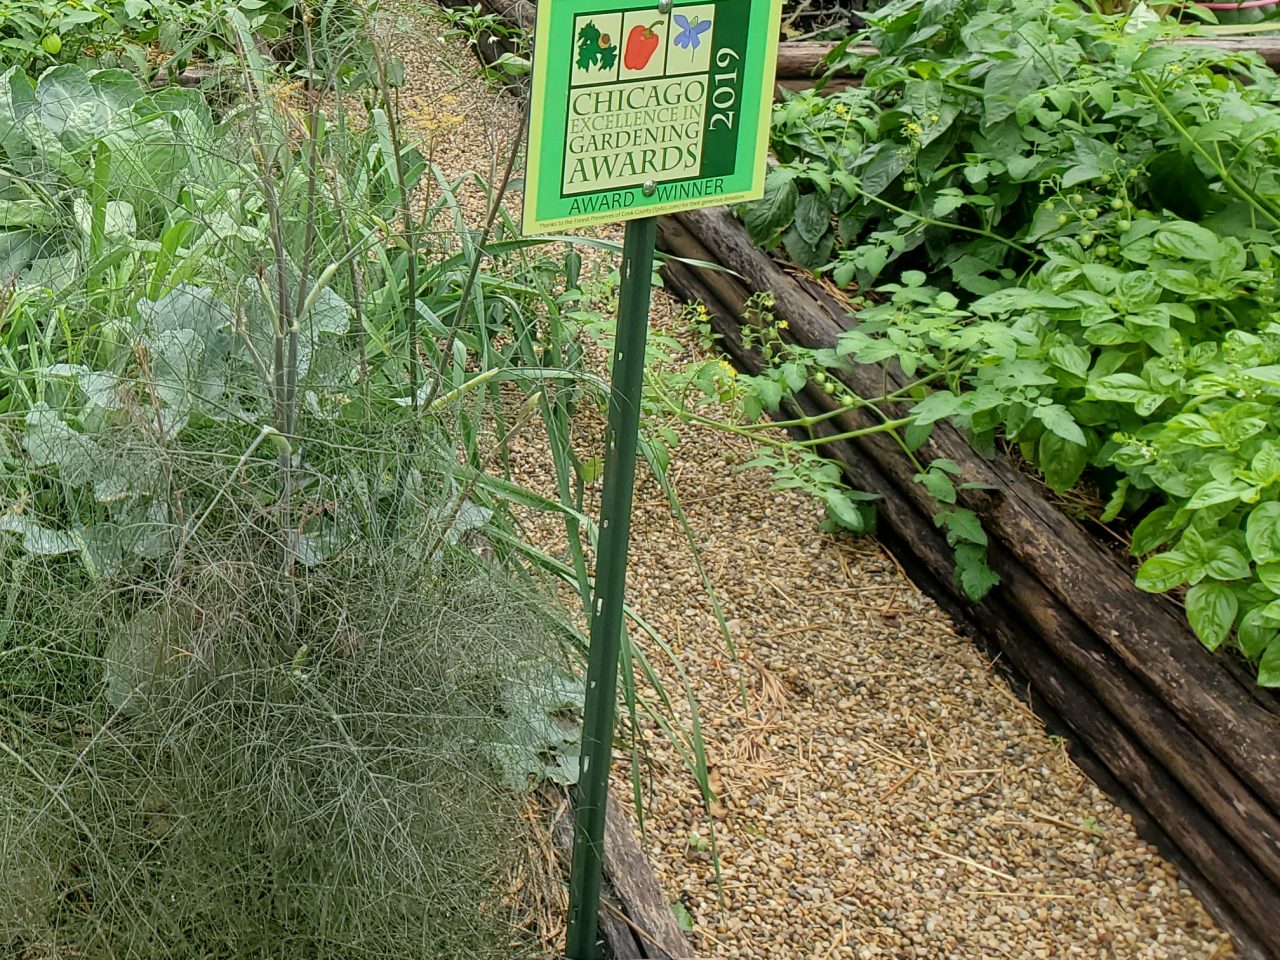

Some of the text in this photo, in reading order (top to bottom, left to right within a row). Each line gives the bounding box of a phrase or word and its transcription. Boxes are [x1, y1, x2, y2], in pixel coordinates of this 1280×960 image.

[572, 80, 705, 116] CHICAGO
[708, 47, 739, 130] 2019
[570, 103, 703, 134] EXCELLENCE IN
[569, 122, 699, 154] GARDENING
[569, 143, 698, 184] AWARDS
[569, 178, 724, 215] AWARD WINNER
